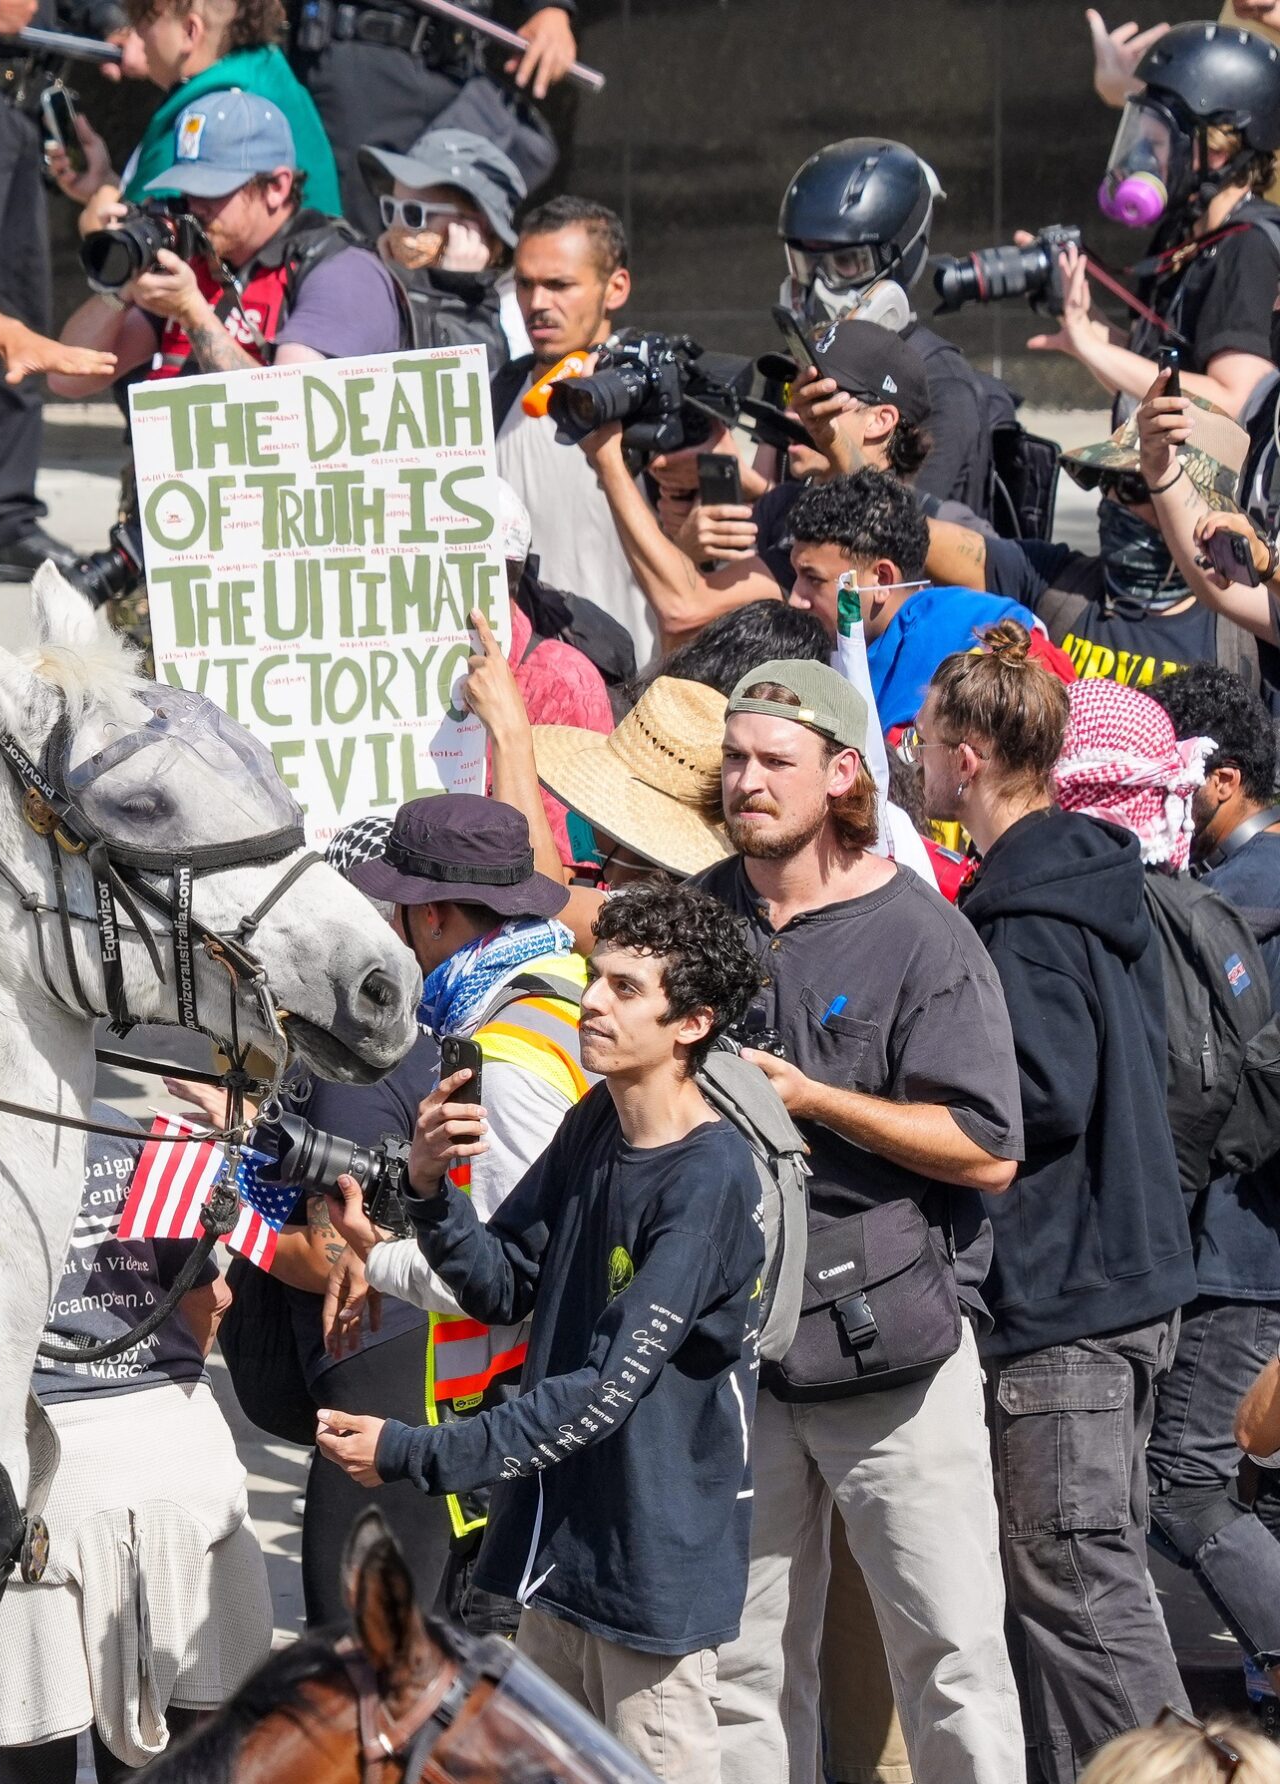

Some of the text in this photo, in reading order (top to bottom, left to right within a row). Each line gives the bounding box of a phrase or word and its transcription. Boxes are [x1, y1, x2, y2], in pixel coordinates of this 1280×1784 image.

[133, 358, 483, 471] THE DEATH
[145, 466, 495, 552] OF TRUTH IS
[151, 565, 256, 647] THE
[1061, 633, 1189, 688] NIRVA
[271, 732, 448, 814] EVIL
[98, 881, 118, 963] Equivizor
[818, 1260, 856, 1280] Canon
